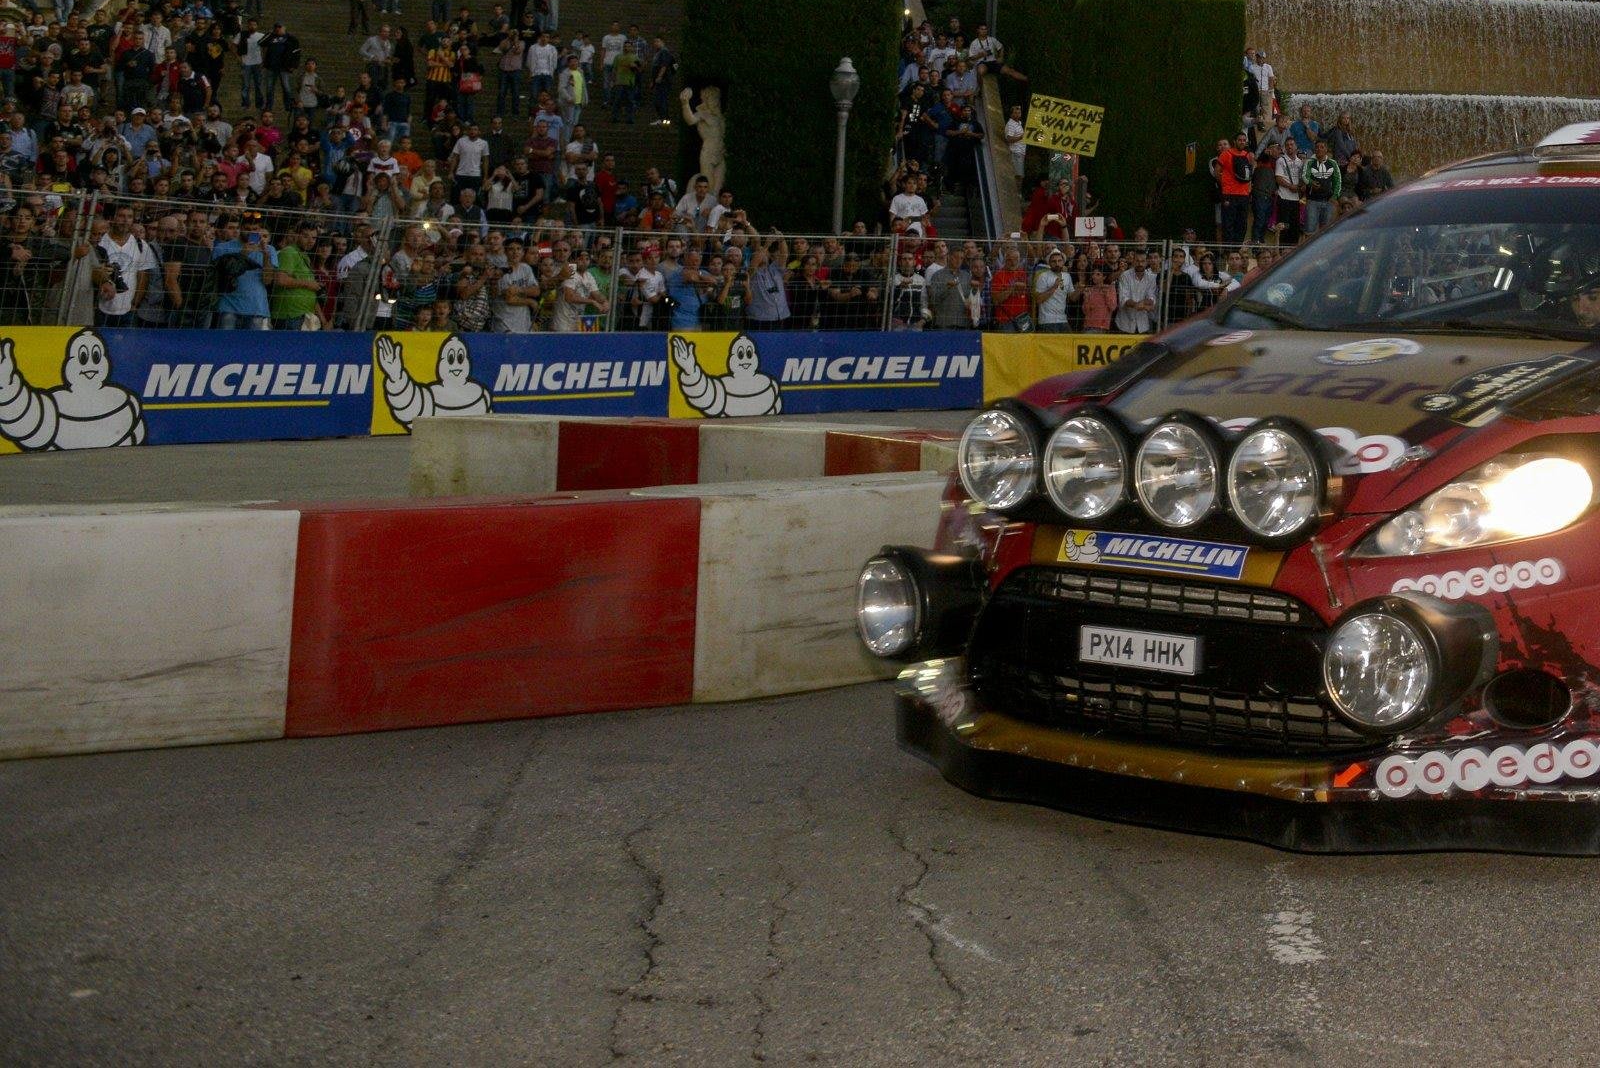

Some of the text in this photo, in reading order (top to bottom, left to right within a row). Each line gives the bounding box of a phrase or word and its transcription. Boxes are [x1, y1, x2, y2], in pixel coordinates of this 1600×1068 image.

[1026, 127, 1096, 153] TO VOTE
[1041, 115, 1091, 135] WANT
[142, 363, 371, 398] MICHELIN
[493, 360, 667, 392] MICHELIN
[781, 354, 981, 382] MICHELIN
[1171, 366, 1440, 405] Qatar
[1103, 537, 1245, 567] MICHELIN
[1089, 632, 1185, 667] PX14 HHK
